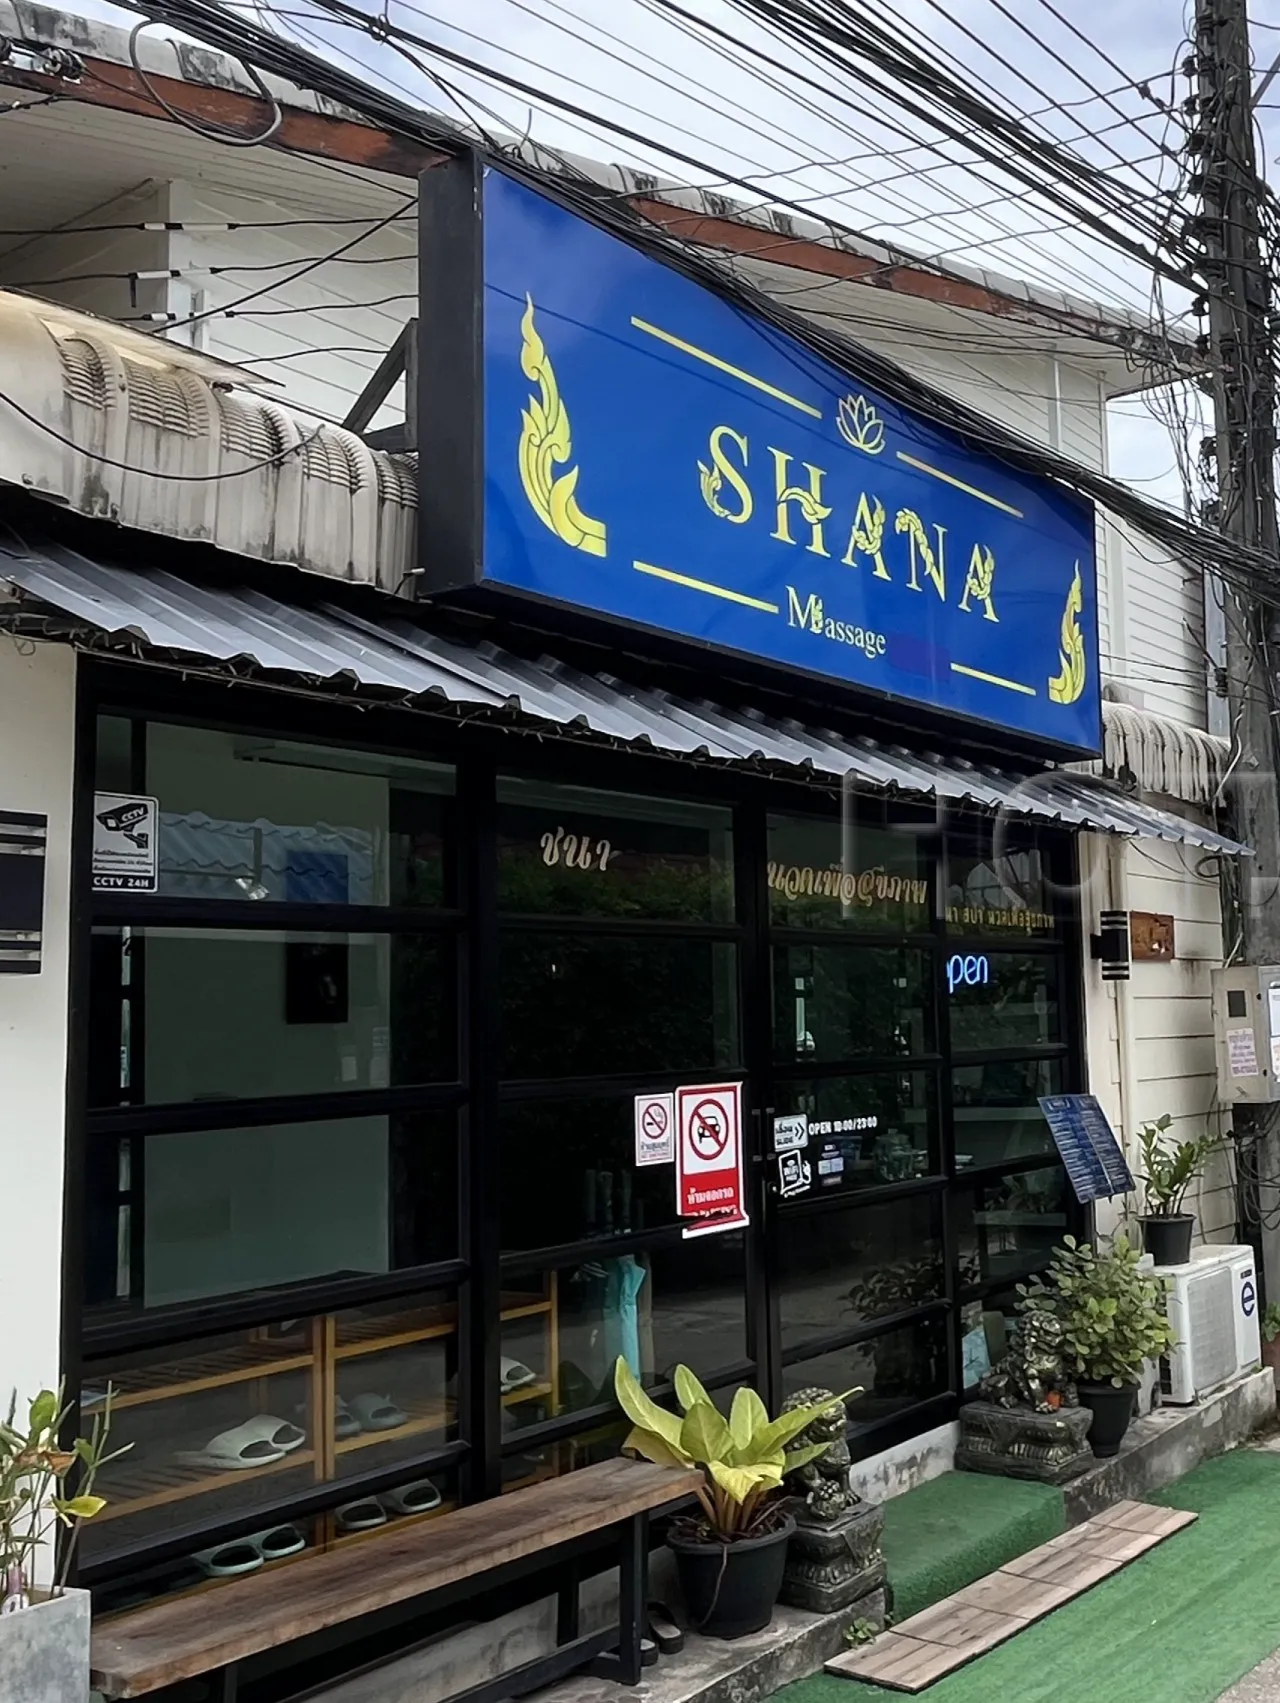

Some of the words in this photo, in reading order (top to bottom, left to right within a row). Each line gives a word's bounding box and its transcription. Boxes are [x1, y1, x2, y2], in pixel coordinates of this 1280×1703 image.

[698, 425, 999, 623] SHANA
[786, 585, 887, 659] Massage
[121, 806, 145, 822] CCTV
[93, 876, 124, 886] CCTV
[127, 878, 149, 887] 24H
[946, 954, 988, 994] pen
[808, 1121, 832, 1135] OPEN
